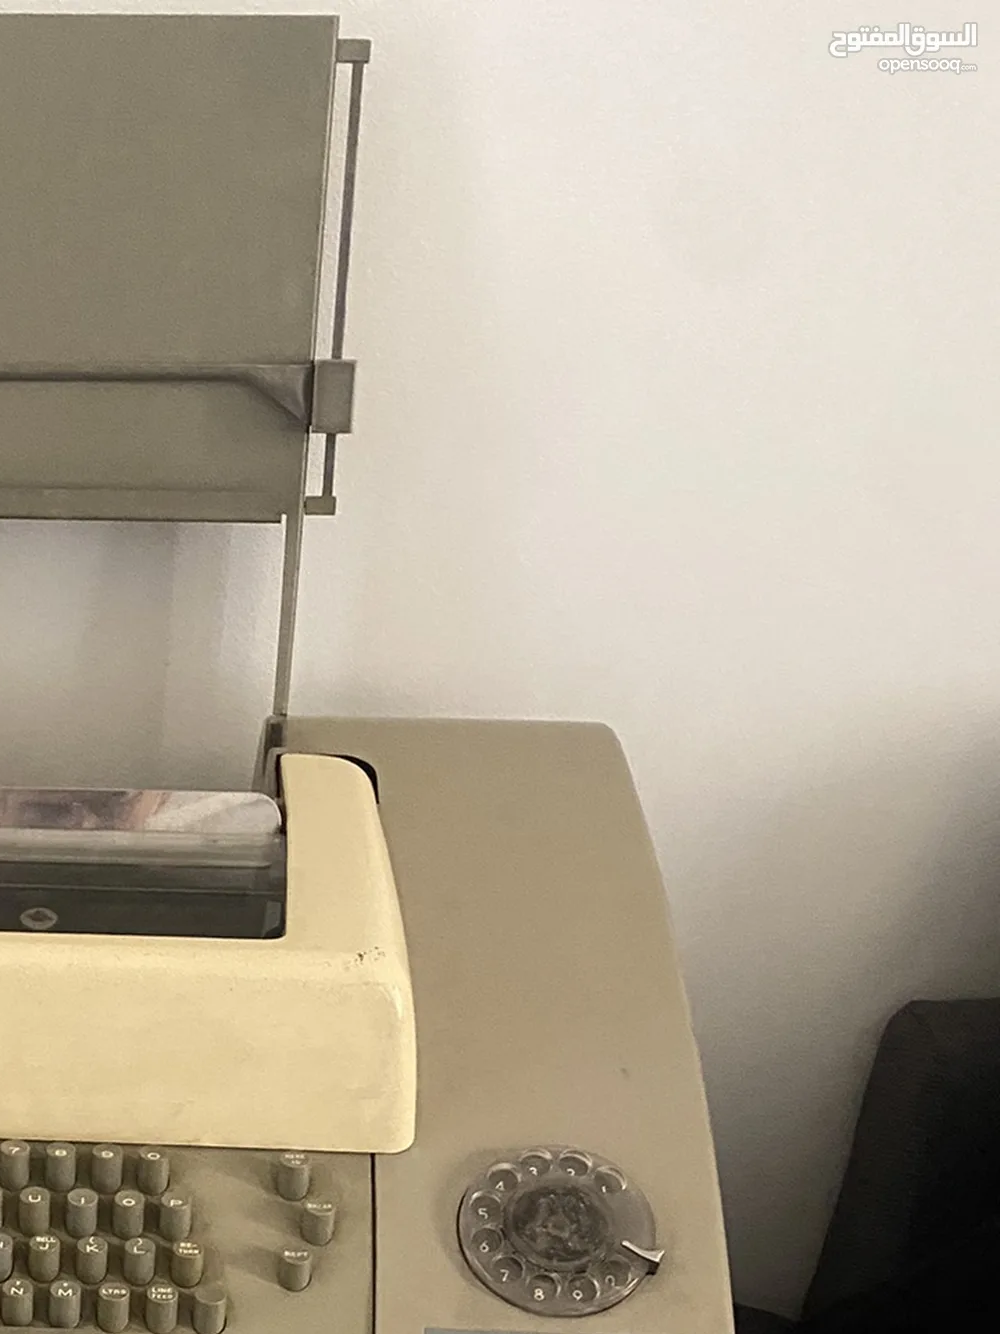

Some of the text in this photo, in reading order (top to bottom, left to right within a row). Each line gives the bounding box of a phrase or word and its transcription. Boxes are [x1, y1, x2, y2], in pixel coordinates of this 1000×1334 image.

[8, 1146, 20, 1154] 7
[494, 1180, 506, 1192] 4
[28, 1194, 41, 1202] U
[478, 1207, 489, 1220] 5
[86, 1244, 99, 1253] K
[133, 1246, 146, 1254] L
[479, 1241, 490, 1253] 6
[500, 1269, 510, 1282] 7
[10, 1287, 24, 1296] N
[58, 1288, 73, 1297] M
[533, 1288, 584, 1301] 8 9
